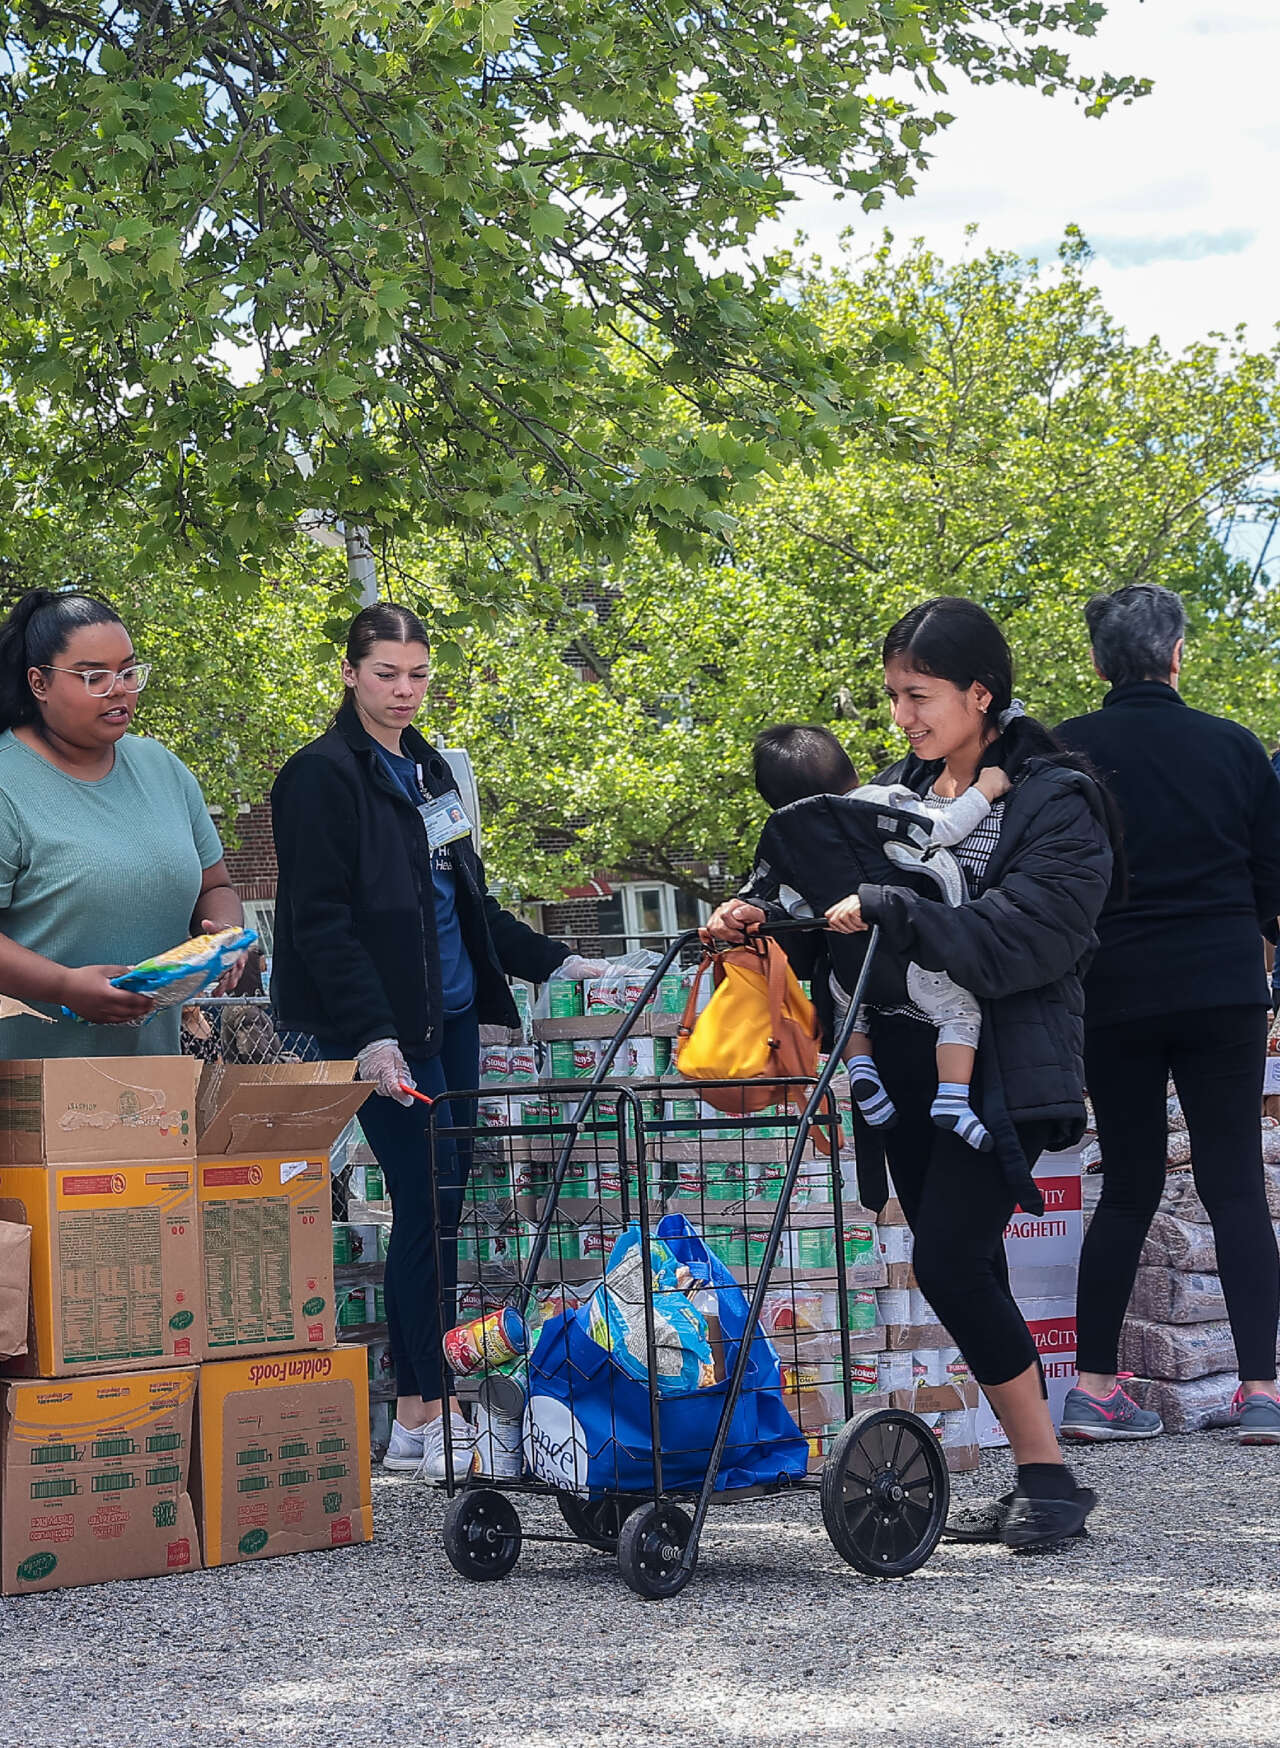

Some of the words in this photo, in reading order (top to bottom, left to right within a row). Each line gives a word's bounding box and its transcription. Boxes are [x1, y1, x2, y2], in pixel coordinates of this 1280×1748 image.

[1003, 1221, 1066, 1239] PAGHETTI
[1032, 1330, 1078, 1347] TACITY
[250, 1362, 288, 1385] Foods
[290, 1358, 332, 1380] Golden
